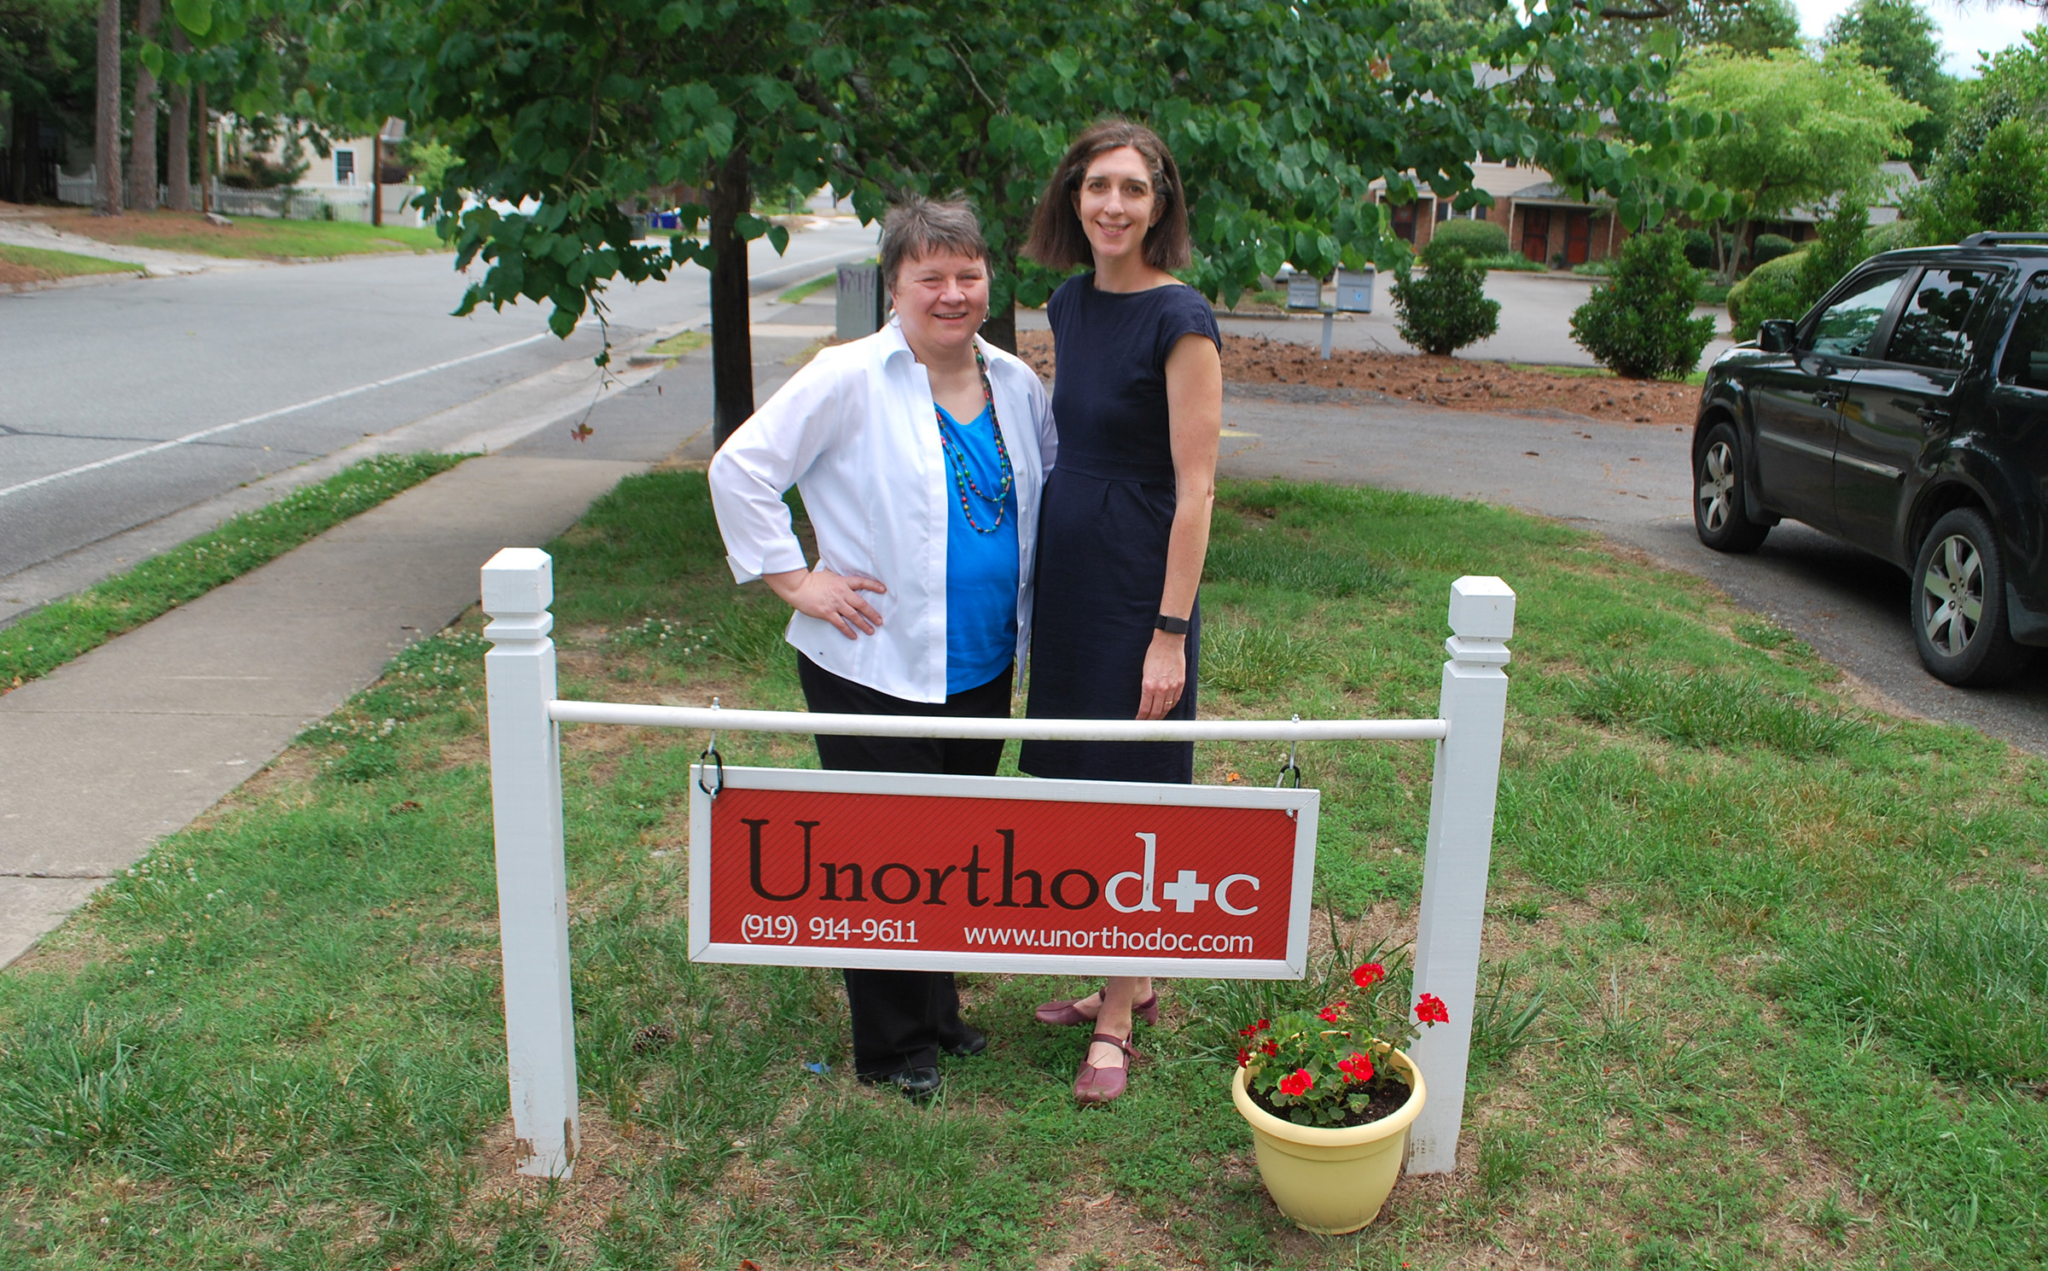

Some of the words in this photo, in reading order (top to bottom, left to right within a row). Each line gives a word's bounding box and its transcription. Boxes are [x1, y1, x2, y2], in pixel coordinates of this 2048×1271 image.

[741, 913, 799, 945] (919)
[808, 916, 919, 943] 914-9611
[963, 926, 1254, 953] www.unorthodoc.com
